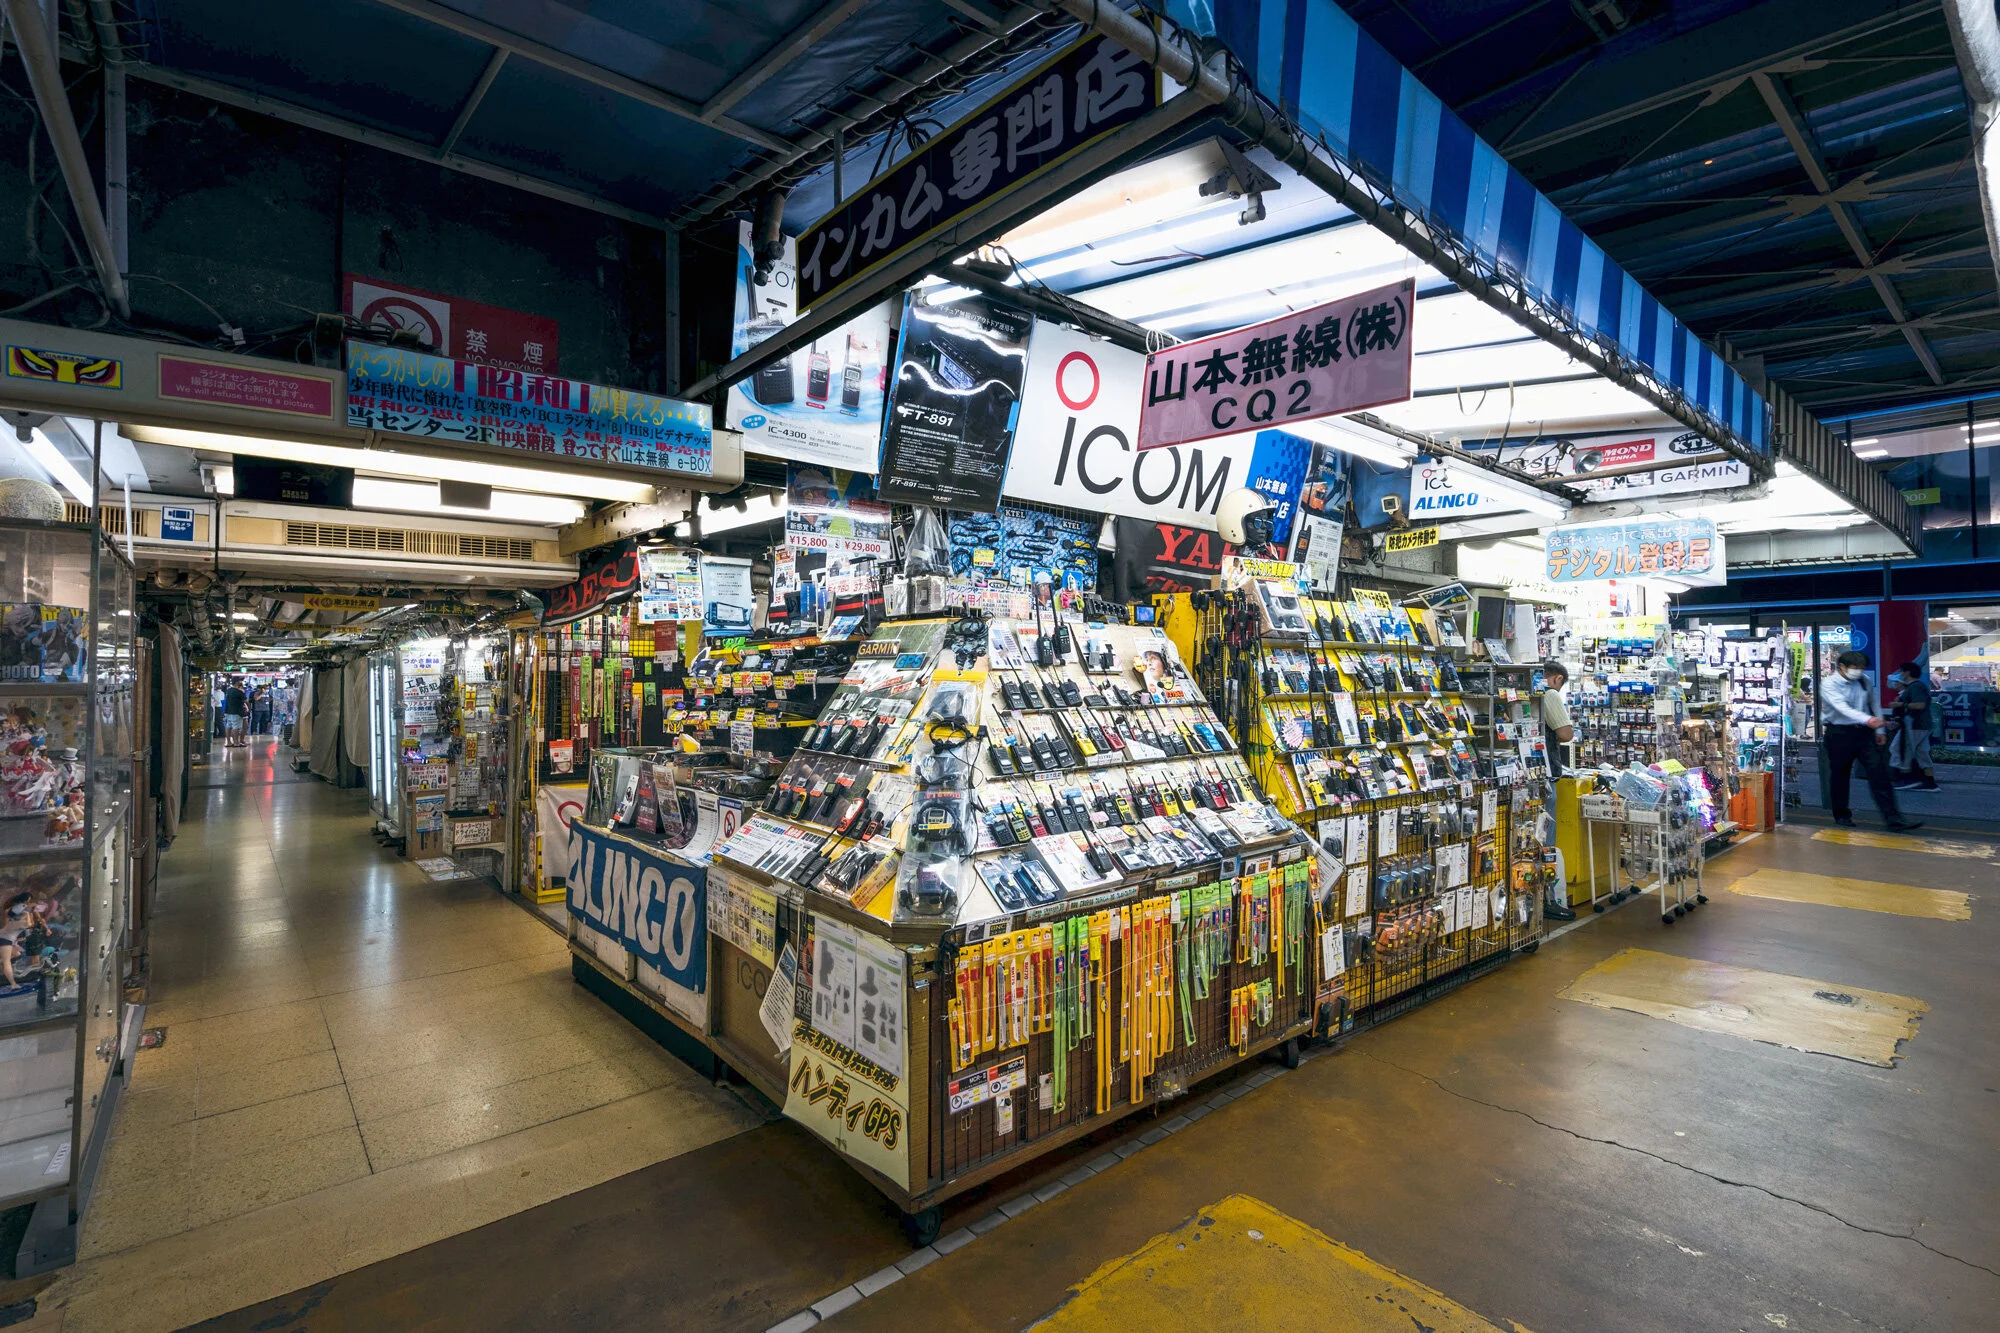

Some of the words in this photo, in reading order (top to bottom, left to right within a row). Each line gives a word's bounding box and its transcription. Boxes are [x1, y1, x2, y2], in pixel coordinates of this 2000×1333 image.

[466, 328, 544, 365] 禁煙
[1148, 296, 1407, 407] 山本無線(株)
[199, 368, 299, 390] ラジオセンター内での
[176, 384, 191, 394] We
[194, 386, 210, 396] will
[212, 390, 242, 400] refuse
[245, 393, 273, 405] taking
[902, 408, 954, 427] FT-891
[767, 425, 807, 440] IC-4300
[677, 456, 711, 473] e-BOX
[1053, 416, 1233, 516] ICOM
[1660, 463, 1740, 484] GARMIN
[889, 478, 917, 488] FT-891
[1255, 477, 1287, 496] 山本無線
[1414, 492, 1480, 510] ALINCO
[1004, 509, 1026, 519] KTEL
[1062, 520, 1081, 530] KTEL
[789, 535, 828, 548] ¥15,800
[844, 541, 881, 553] ¥29,800
[1388, 530, 1436, 550] 防犯カメラ作動中
[1547, 538, 1712, 580] デジタル登録局
[1818, 632, 1851, 642] elcia
[858, 643, 900, 655] GARMIN
[895, 654, 925, 668] GPS
[566, 830, 696, 971] ALINCO
[736, 956, 767, 1000] ICO
[790, 1056, 902, 1150] ハンディGPS
